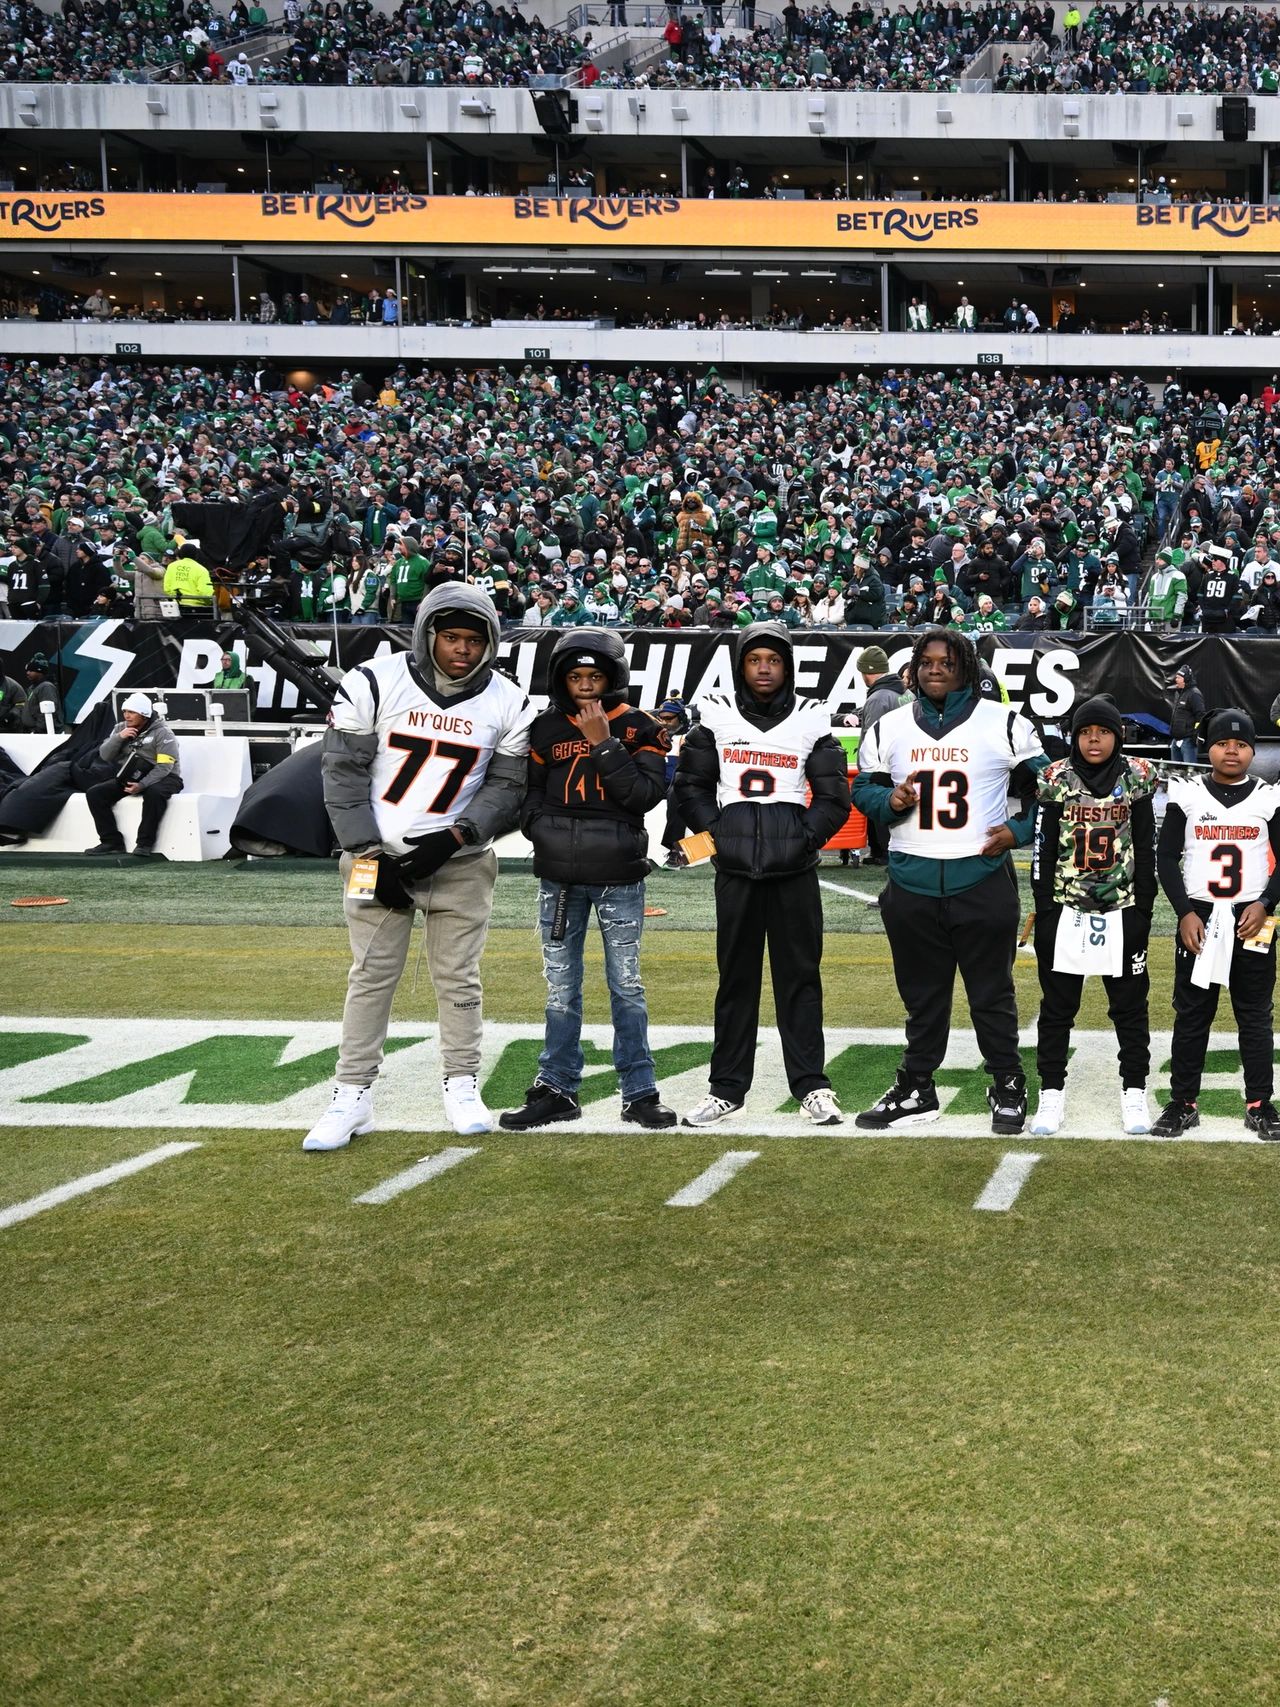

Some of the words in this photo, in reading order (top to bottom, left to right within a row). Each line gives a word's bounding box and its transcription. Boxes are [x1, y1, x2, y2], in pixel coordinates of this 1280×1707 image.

[836, 207, 979, 242] BETRIVERS
[118, 343, 139, 353] 102
[529, 349, 547, 358] 101
[980, 354, 1001, 363] 138
[12, 573, 28, 590] 11
[397, 565, 411, 583] 11
[1206, 580, 1227, 598] 99
[408, 710, 474, 736] NY'QUES
[722, 748, 799, 769] PANTHERS
[910, 747, 969, 763] NY'QUES
[380, 731, 481, 815] 77
[914, 769, 969, 831] 13
[1061, 805, 1130, 823] CHESTER
[1194, 825, 1261, 840] PANTHERS
[1072, 826, 1118, 870] 19
[1207, 843, 1244, 899] 3
[553, 890, 567, 937] lululemon
